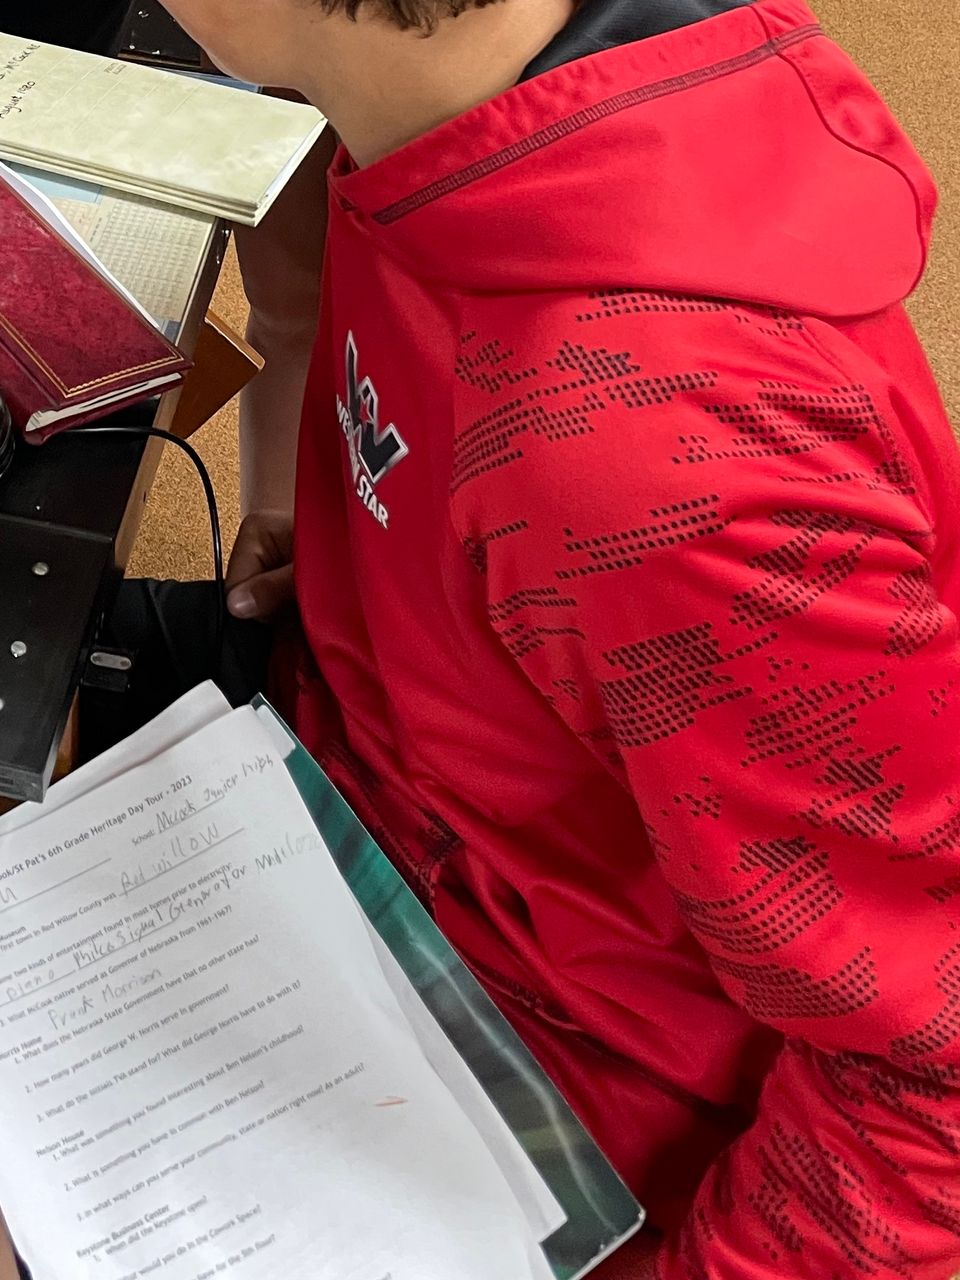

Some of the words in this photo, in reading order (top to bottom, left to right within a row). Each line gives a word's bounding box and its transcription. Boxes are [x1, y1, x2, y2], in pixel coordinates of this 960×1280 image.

[16, 80, 37, 96] 1980
[356, 474, 390, 530] STAR
[24, 853, 46, 868] Pat's
[47, 845, 63, 856] 6th
[63, 832, 89, 848] Grade
[89, 812, 126, 835] Heritage
[127, 802, 143, 816] Day
[144, 791, 163, 806] Tour
[170, 775, 192, 792] 2023
